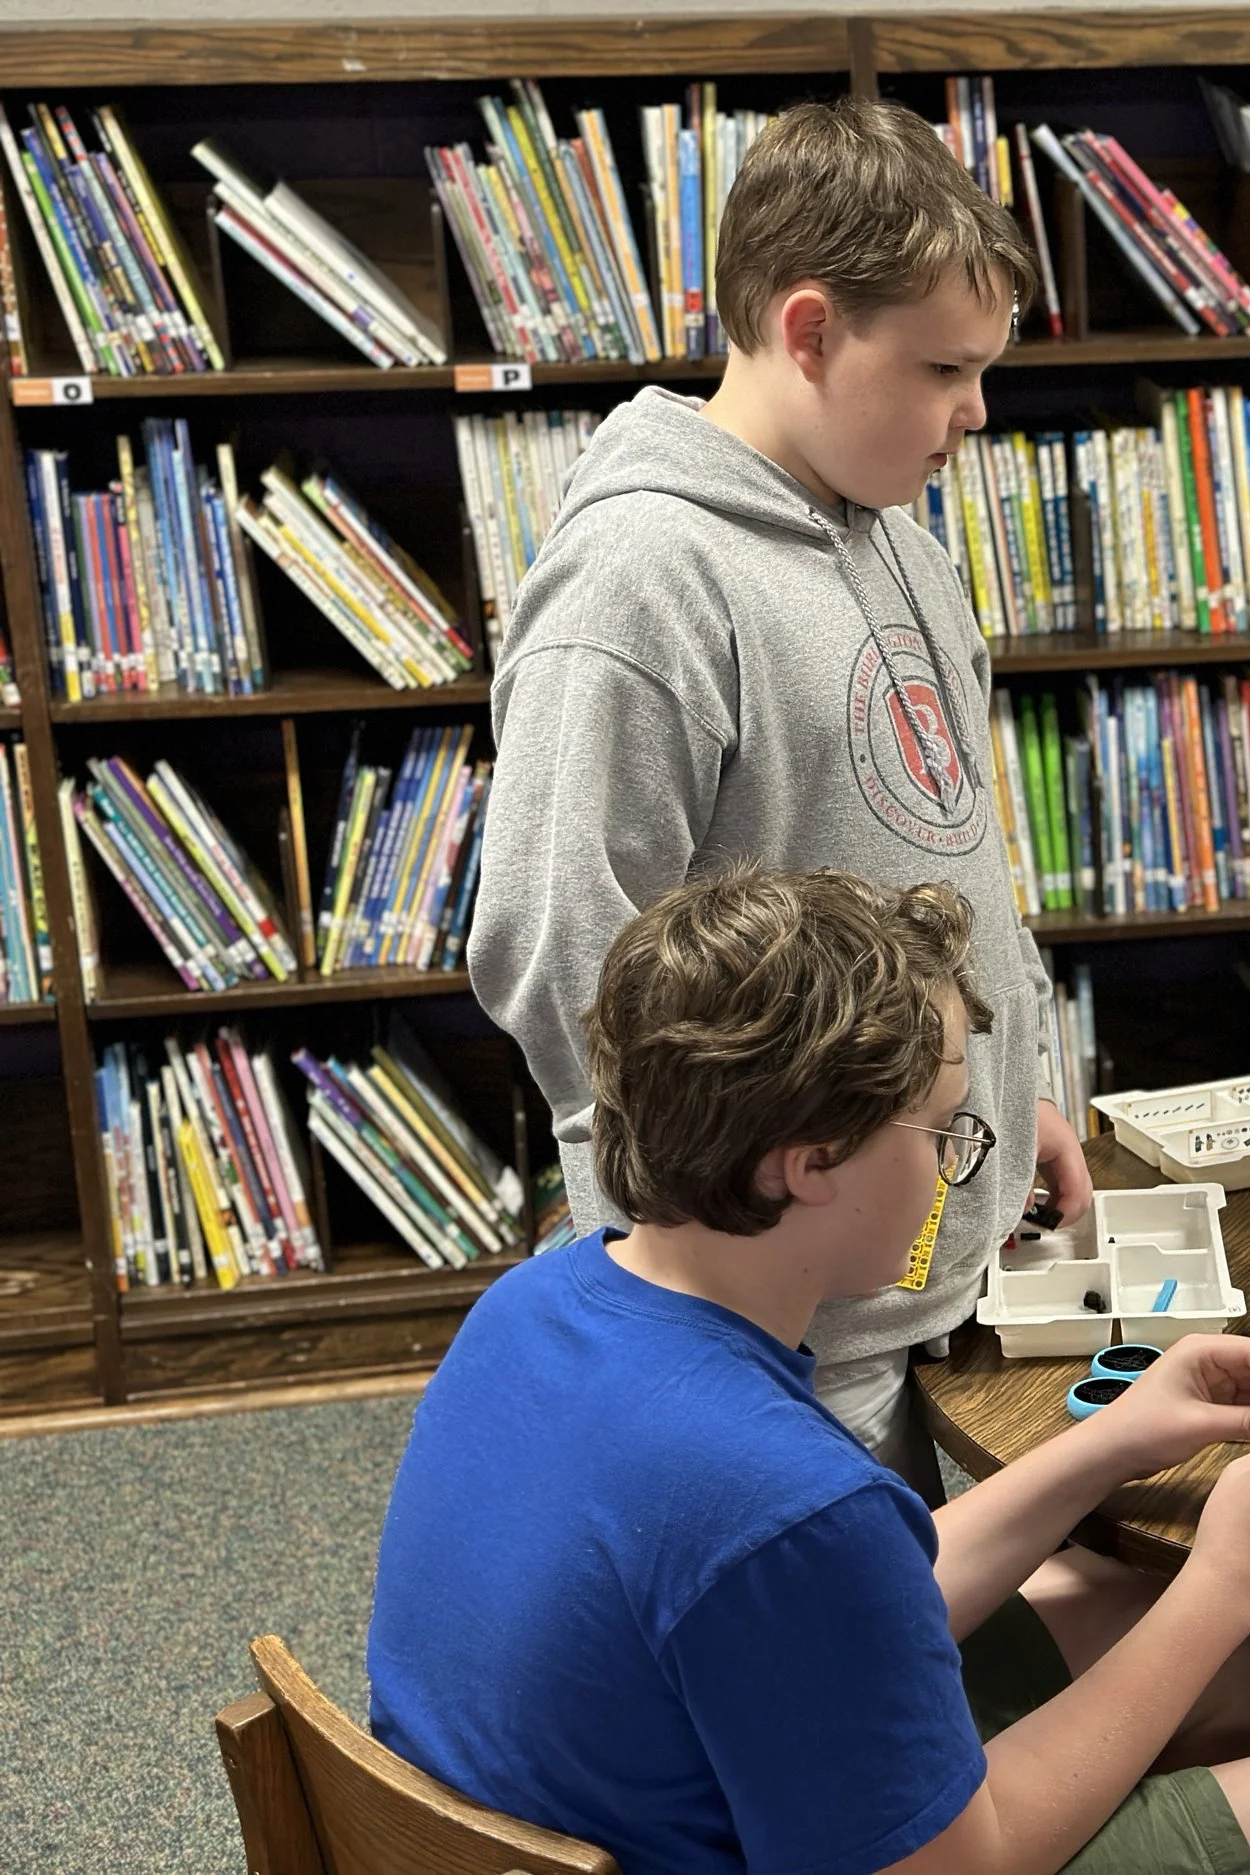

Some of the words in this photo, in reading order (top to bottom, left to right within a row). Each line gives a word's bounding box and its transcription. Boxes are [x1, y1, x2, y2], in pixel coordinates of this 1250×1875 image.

[62, 383, 82, 401] O
[502, 369, 520, 385] P
[854, 691, 866, 734] THE
[863, 775, 937, 843] DISCOVER
